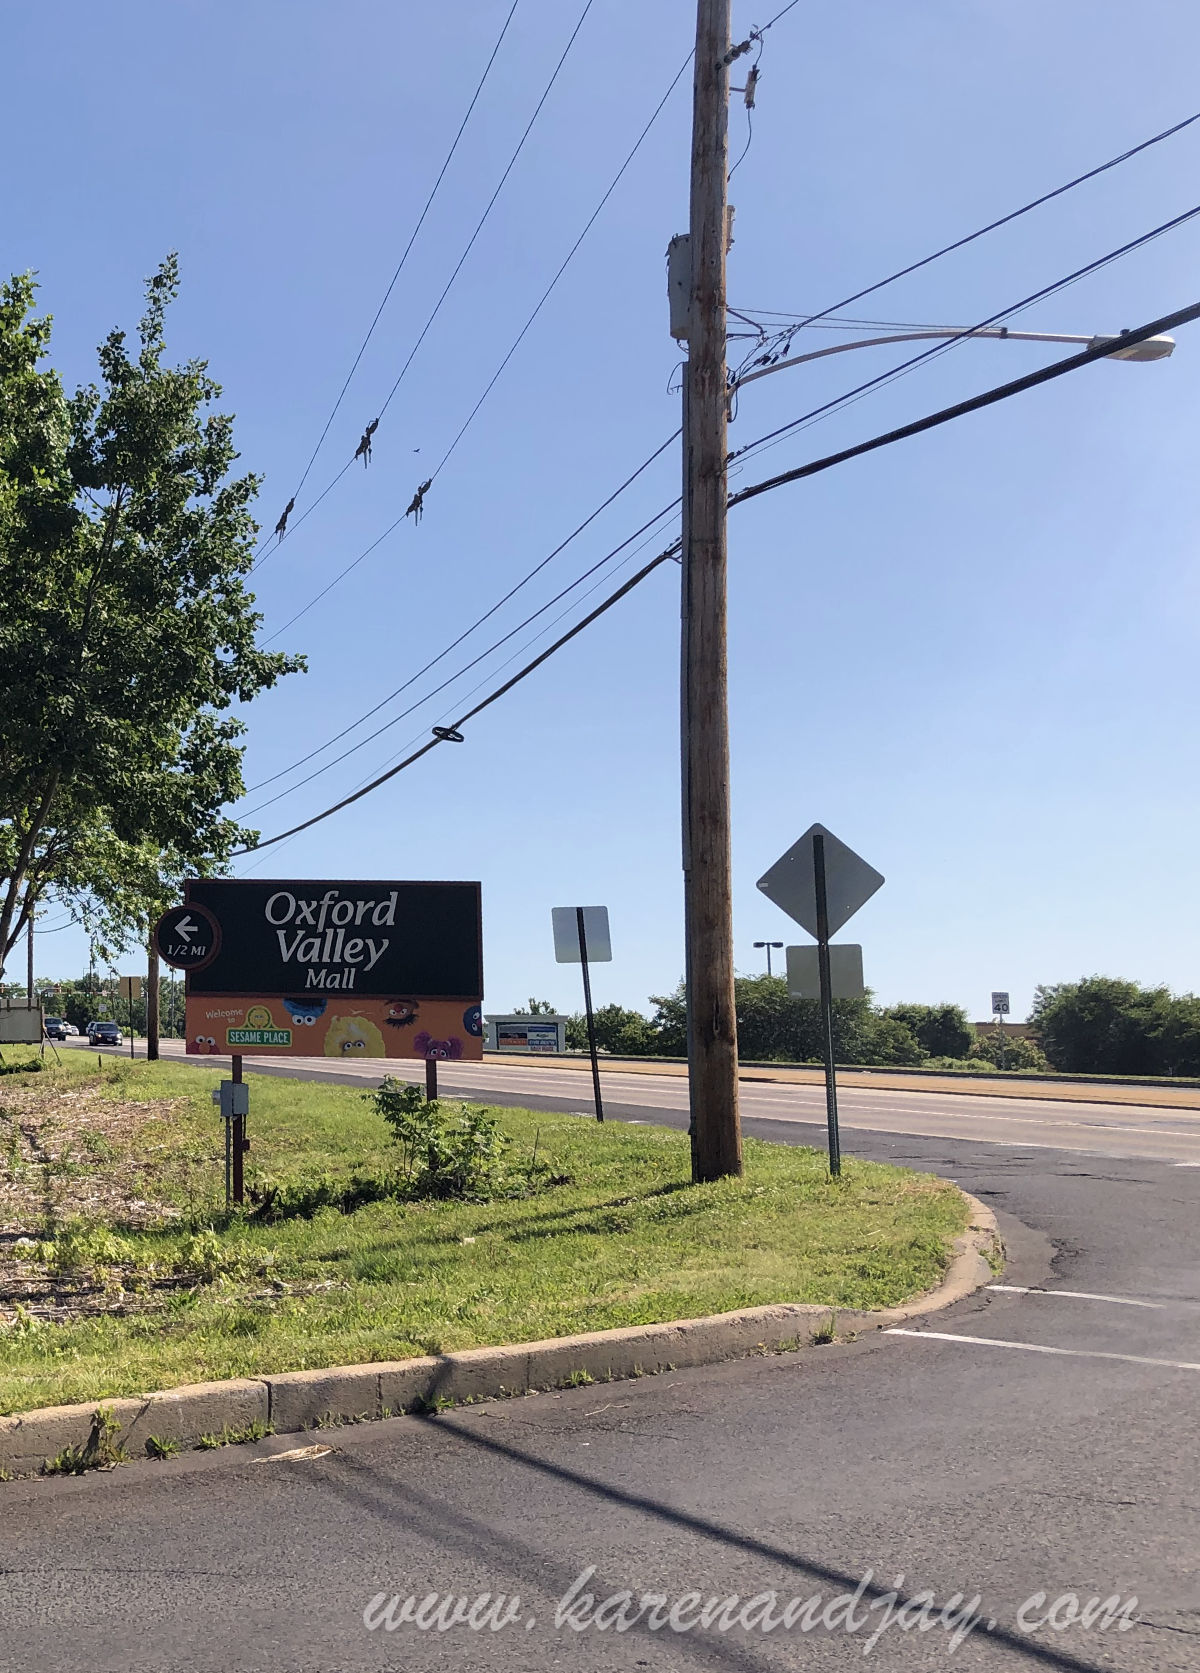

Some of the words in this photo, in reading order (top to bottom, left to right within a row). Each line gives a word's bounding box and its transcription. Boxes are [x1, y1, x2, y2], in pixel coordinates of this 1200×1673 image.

[264, 890, 399, 933] Oxford
[167, 944, 188, 957] 1/2
[190, 945, 207, 956] MI
[276, 928, 390, 971] Valley
[304, 967, 356, 989] Mall
[205, 1008, 244, 1019] Welcome
[993, 1003, 1009, 1012] 40
[230, 1031, 262, 1043] SESAME
[263, 1031, 289, 1044] PLACE
